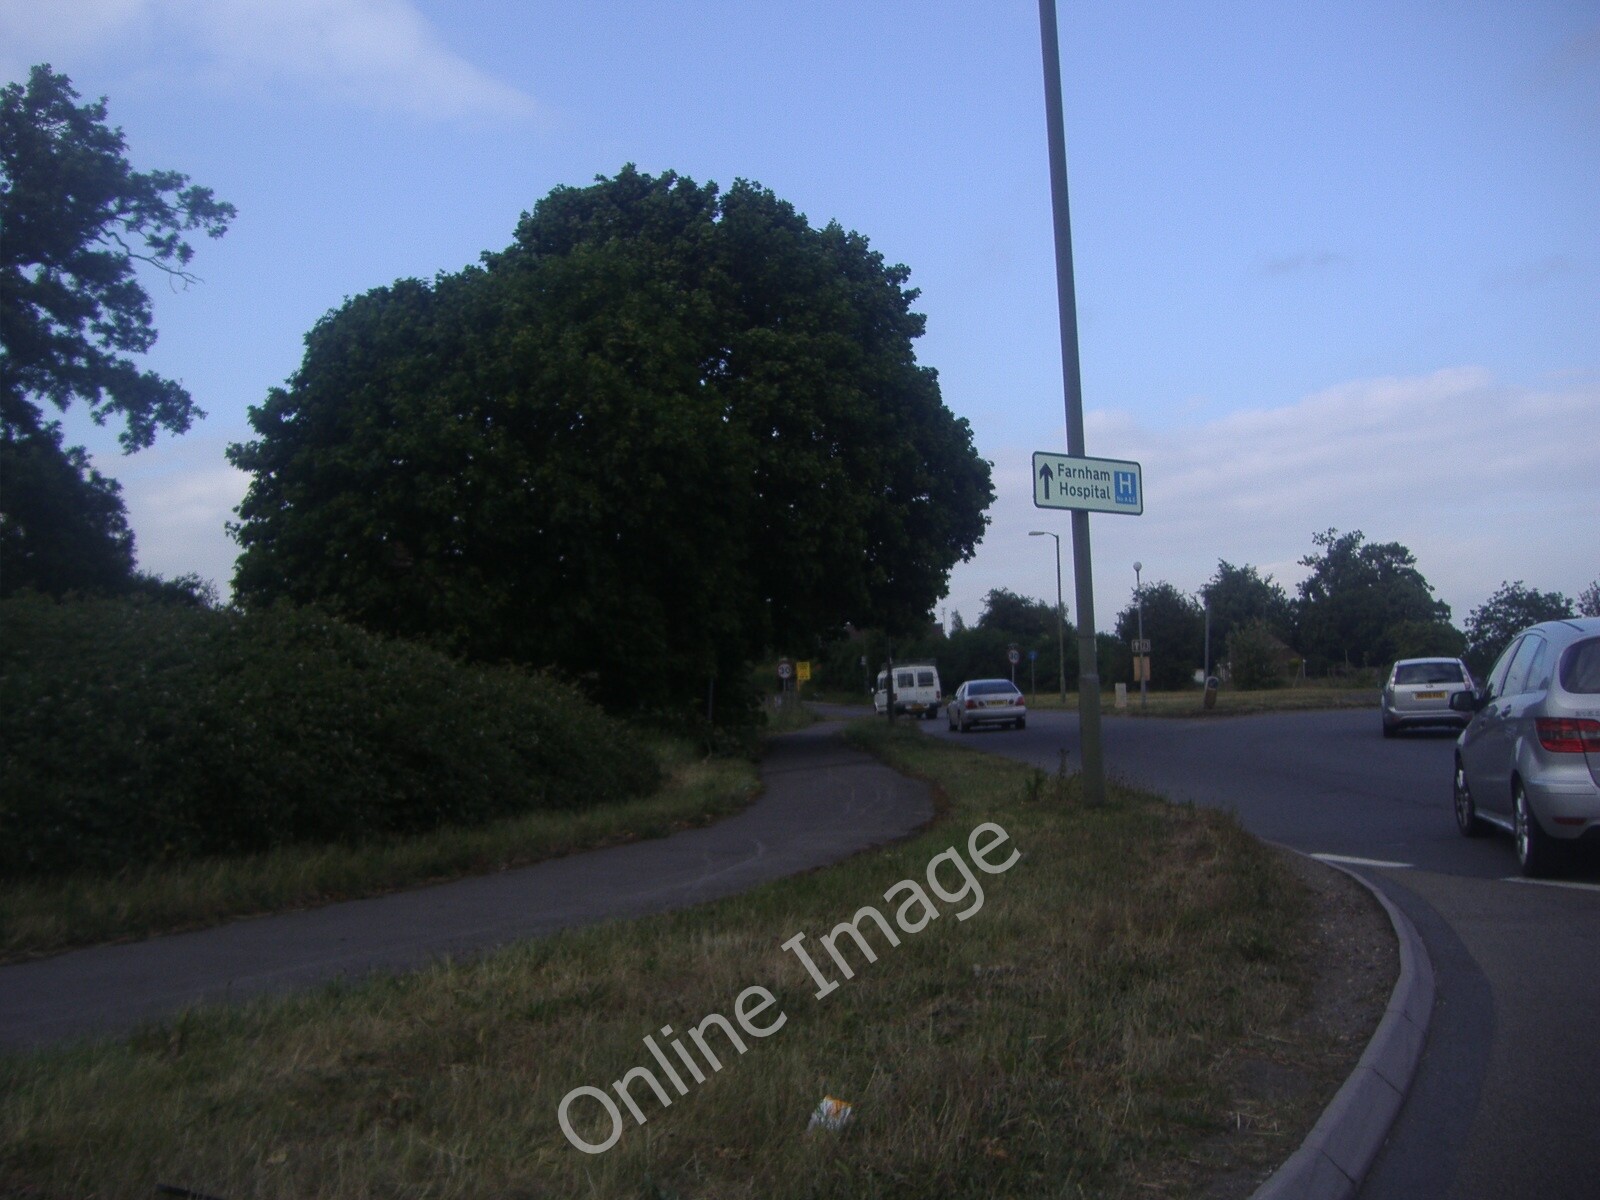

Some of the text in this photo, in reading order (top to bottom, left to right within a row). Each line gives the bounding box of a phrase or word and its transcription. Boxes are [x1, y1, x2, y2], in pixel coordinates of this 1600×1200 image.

[1057, 463, 1110, 481] Farnham
[1060, 482, 1111, 499] Hospital
[1119, 472, 1132, 494] H
